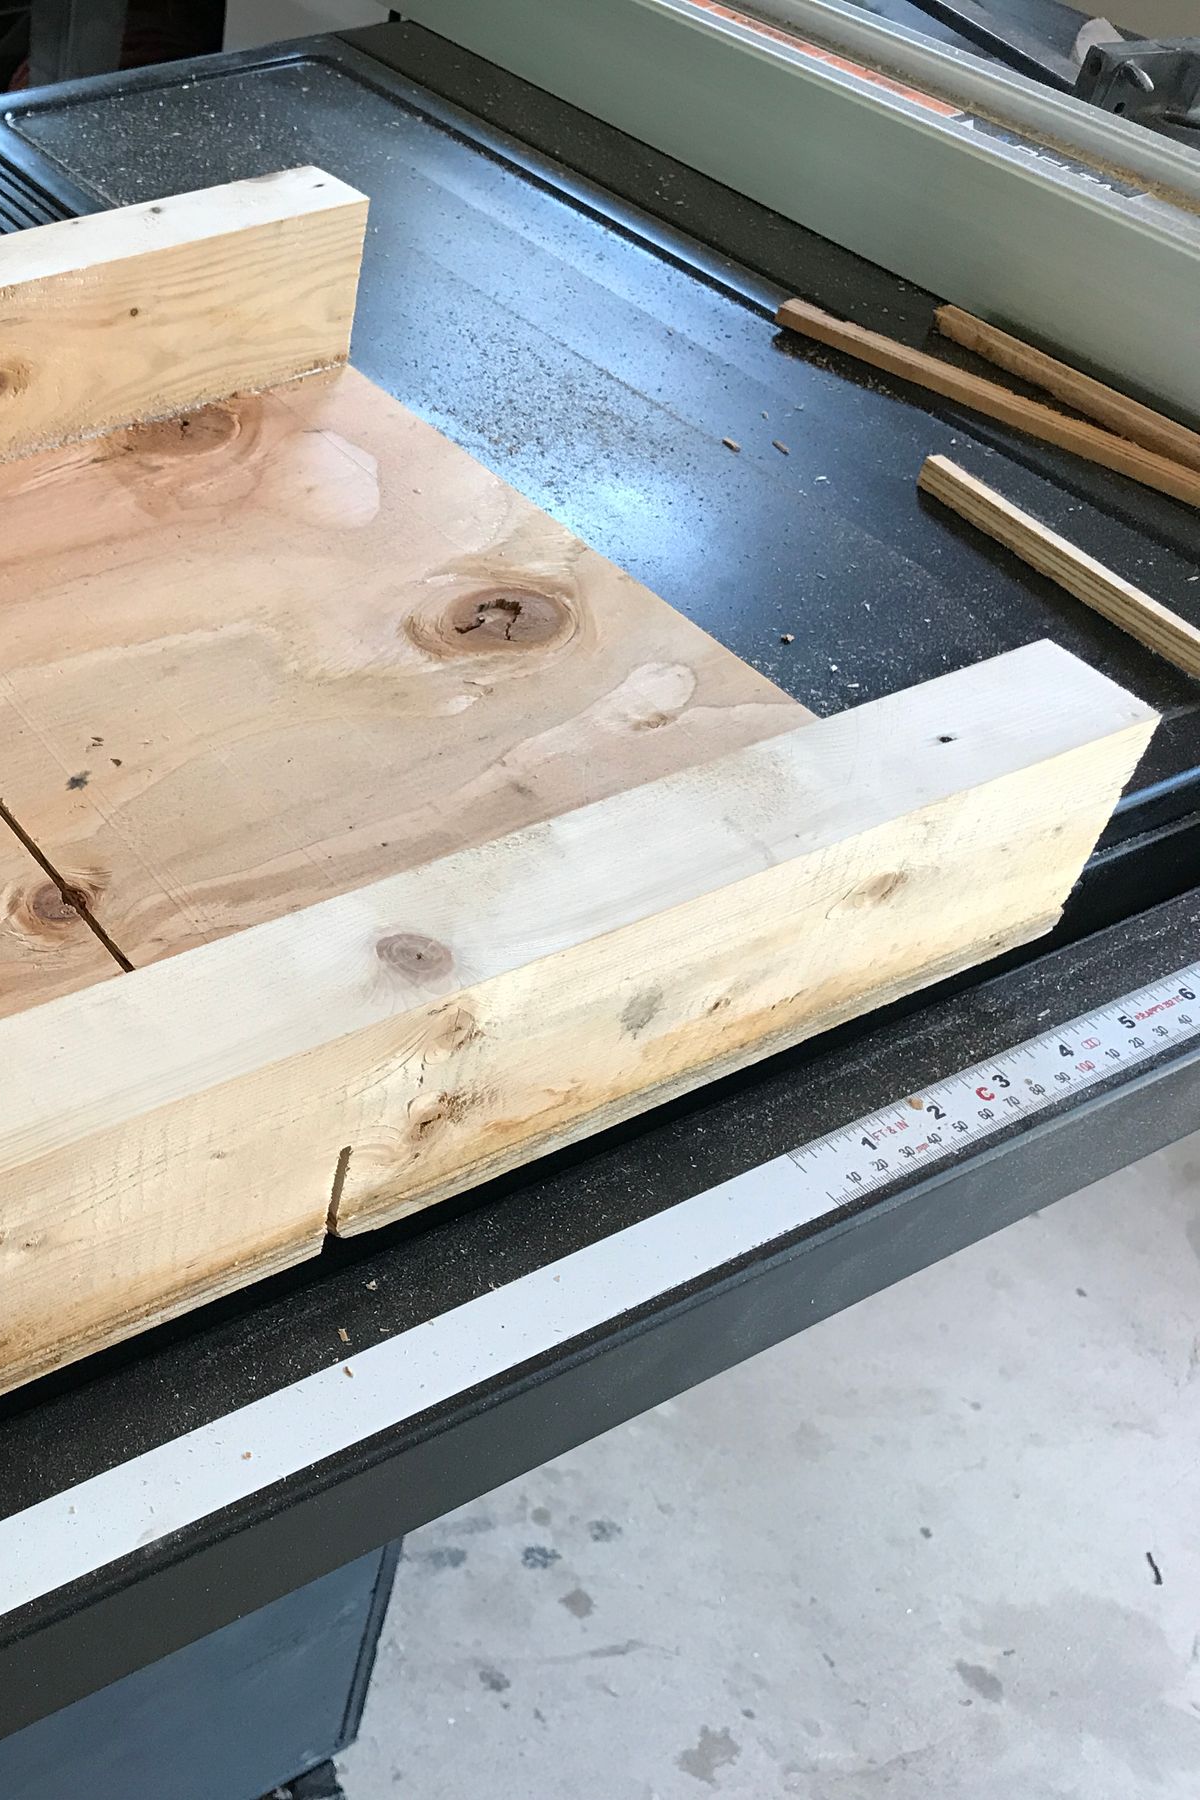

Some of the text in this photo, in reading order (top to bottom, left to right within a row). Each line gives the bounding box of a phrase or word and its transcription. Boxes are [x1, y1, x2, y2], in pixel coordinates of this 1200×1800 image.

[846, 1171, 862, 1183] 10
[873, 1158, 888, 1172] 20
[898, 1146, 915, 1158] 30
[927, 1133, 942, 1145] 40
[952, 1120, 969, 1133] 50
[978, 1108, 994, 1120] 60
[1003, 1095, 1020, 1107] 70
[1029, 1083, 1045, 1096] 80
[1054, 1071, 1071, 1084] 90
[1075, 1060, 1095, 1072] 100
[1105, 1048, 1121, 1060] 10
[1128, 1037, 1145, 1049] 20
[1152, 1026, 1168, 1037] 30
[1177, 1014, 1192, 1024] 40
[861, 1137, 877, 1150] 1
[927, 1105, 946, 1120] 2
[976, 1087, 995, 1101] C
[992, 1074, 1010, 1088] 3
[1058, 1044, 1074, 1057] 4
[1118, 1016, 1136, 1029] 5
[1178, 988, 1196, 1000] 6
